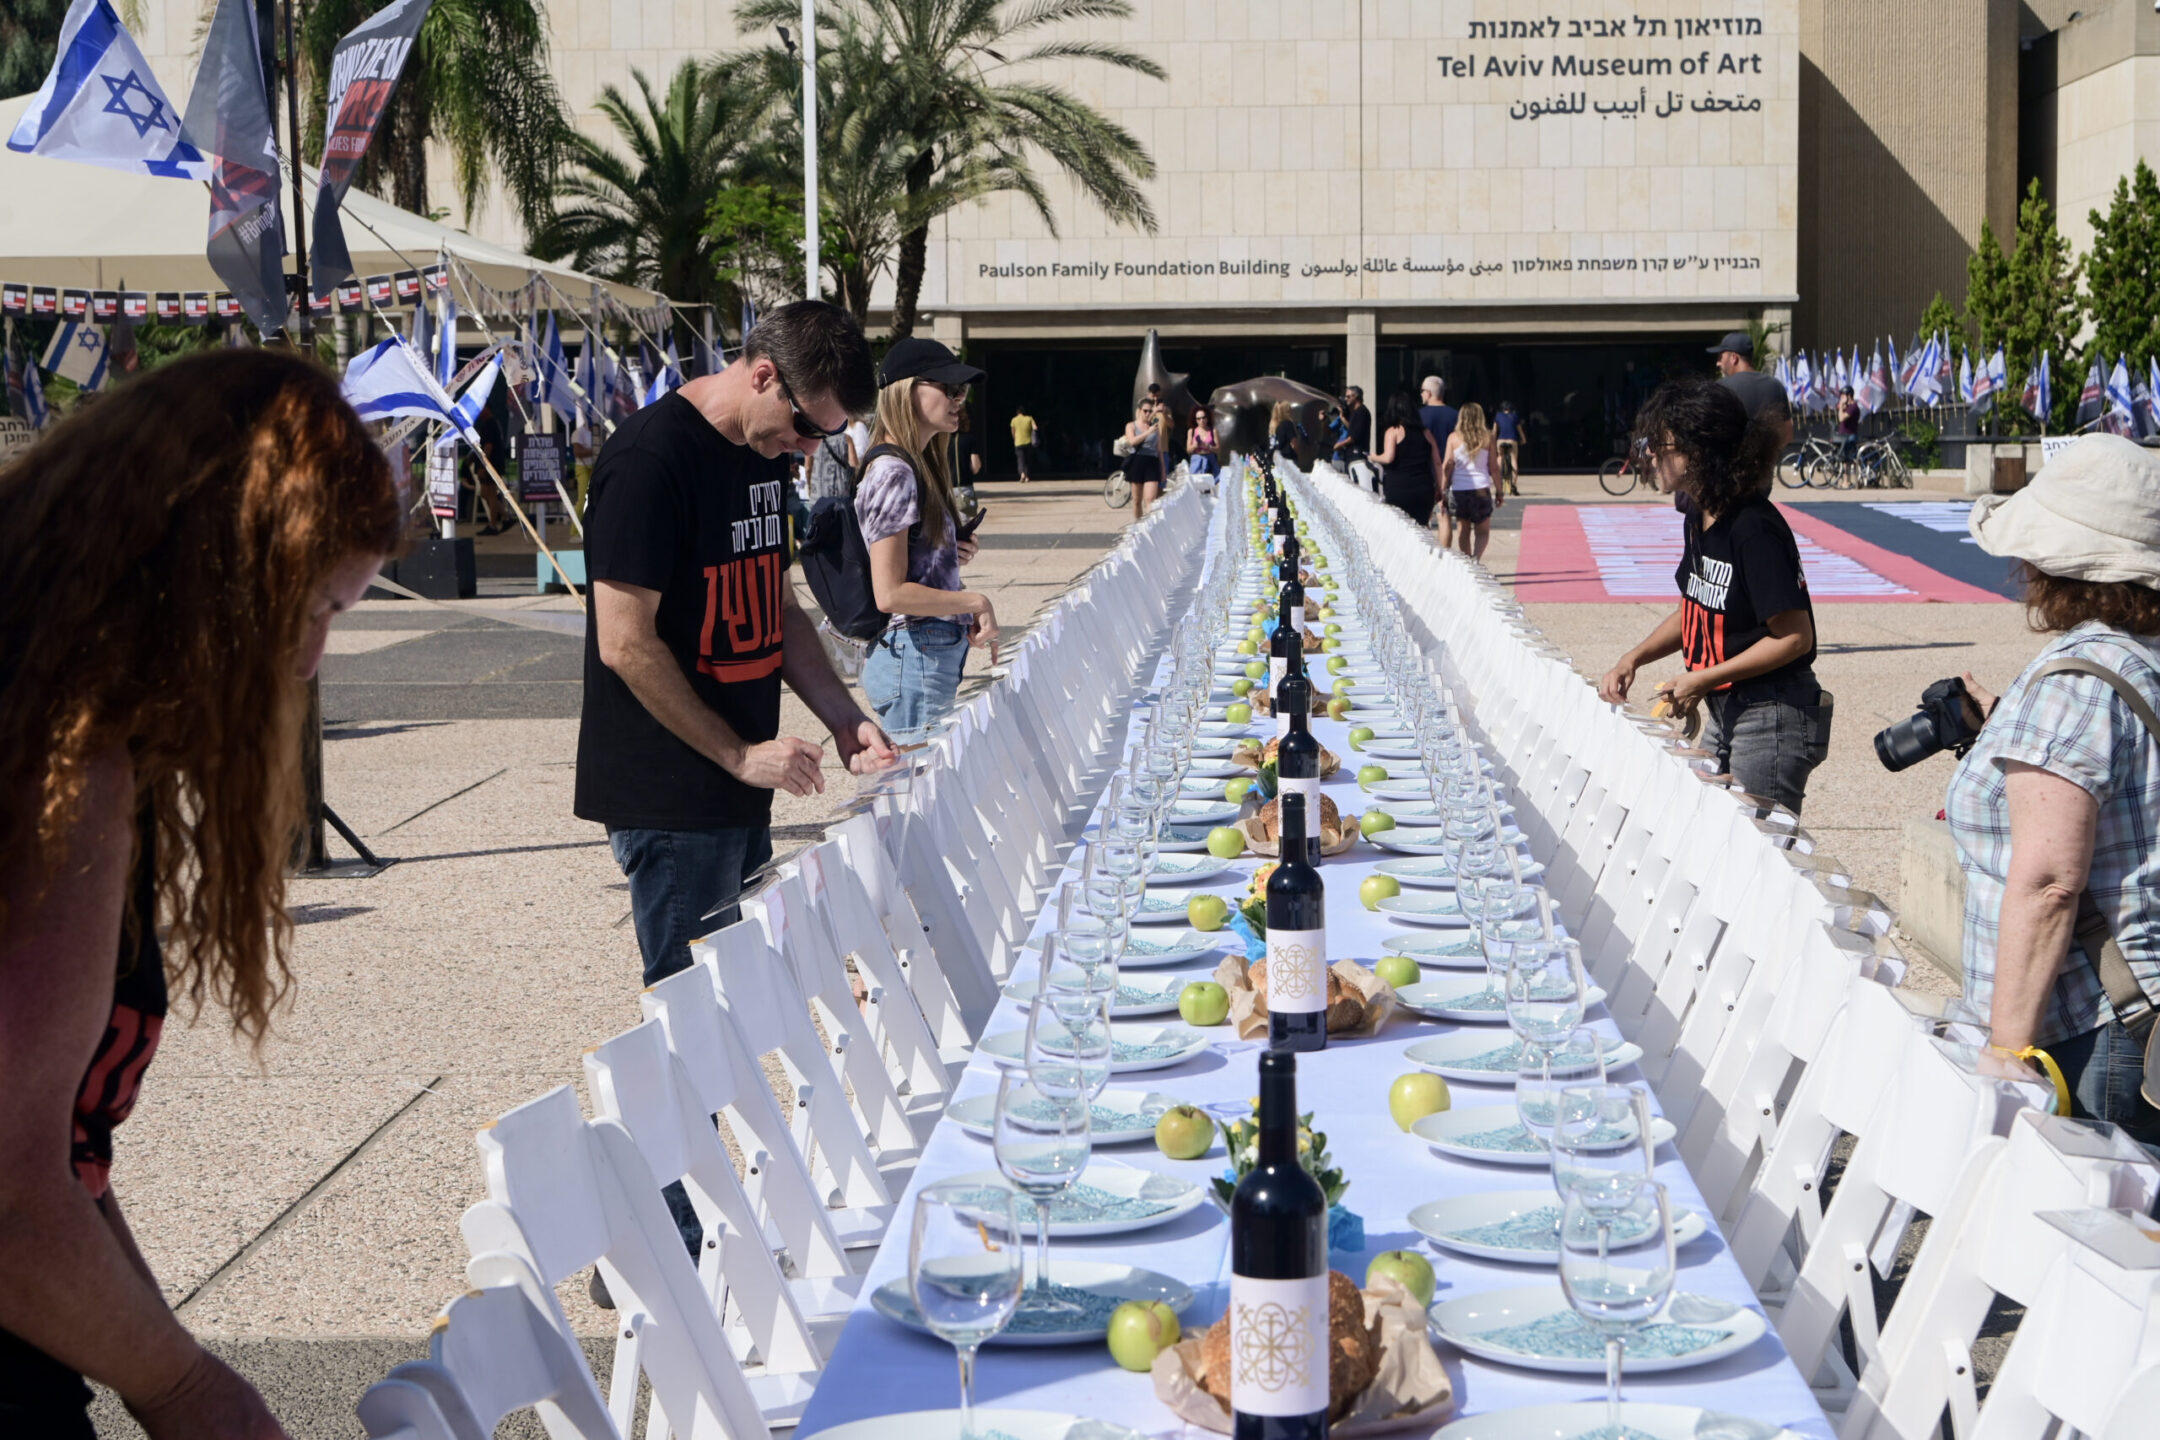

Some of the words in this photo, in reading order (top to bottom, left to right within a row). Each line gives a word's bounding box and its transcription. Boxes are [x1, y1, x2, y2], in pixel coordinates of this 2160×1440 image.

[1468, 15, 1561, 39] לאמנות
[1567, 19, 1626, 38] אביב
[1633, 14, 1667, 37] תל
[1674, 18, 1762, 40] מוזיאון
[1437, 54, 1475, 78] Tel
[1483, 54, 1544, 77] Aviv
[1551, 55, 1672, 77] Museum
[1679, 51, 1710, 75] of
[1717, 53, 1762, 74] Art
[1510, 92, 1586, 121] للفنون
[1593, 86, 1646, 120] أبيب
[1655, 90, 1684, 119] تل
[1690, 90, 1762, 113] متحف
[979, 262, 1047, 278] Paulson
[1052, 261, 1109, 280] Family
[1114, 261, 1215, 276] Foundation
[1219, 260, 1290, 278] Building
[1301, 260, 1358, 277] بولسون
[1362, 258, 1398, 273] عائلة
[1402, 259, 1465, 277] مؤسسة
[1469, 261, 1504, 278] مبنى
[1512, 257, 1573, 274] פאולסון
[1577, 259, 1638, 272] משפחת
[1642, 258, 1669, 273] קרן
[1713, 257, 1761, 271] הבניין
[749, 480, 781, 516] חזירים
